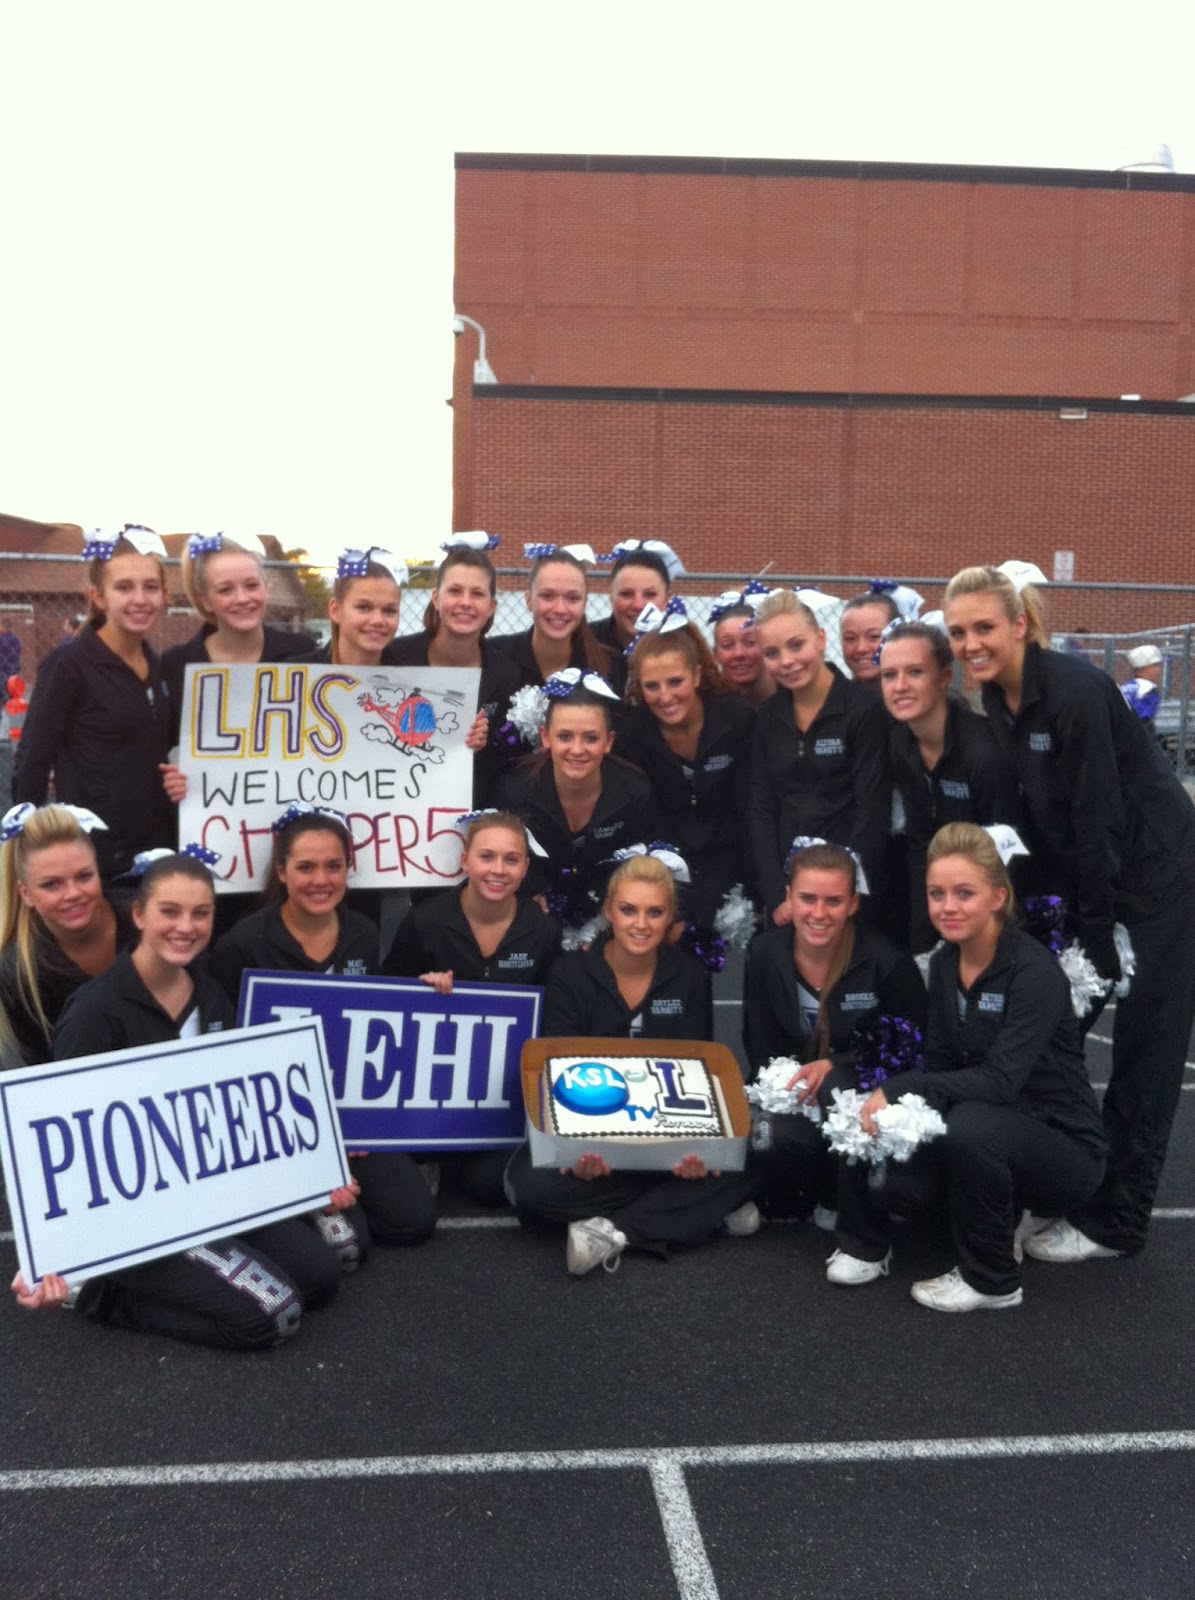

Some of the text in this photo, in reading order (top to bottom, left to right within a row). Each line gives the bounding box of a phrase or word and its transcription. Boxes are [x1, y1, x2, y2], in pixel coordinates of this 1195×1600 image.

[191, 666, 360, 763] LHS
[202, 763, 427, 808] WELCOMES
[202, 808, 469, 879] CHPER5
[271, 1006, 517, 1109] EHI
[563, 1066, 626, 1090] KSL
[29, 1062, 319, 1221] PIONEERS
[623, 1104, 657, 1121] TV
